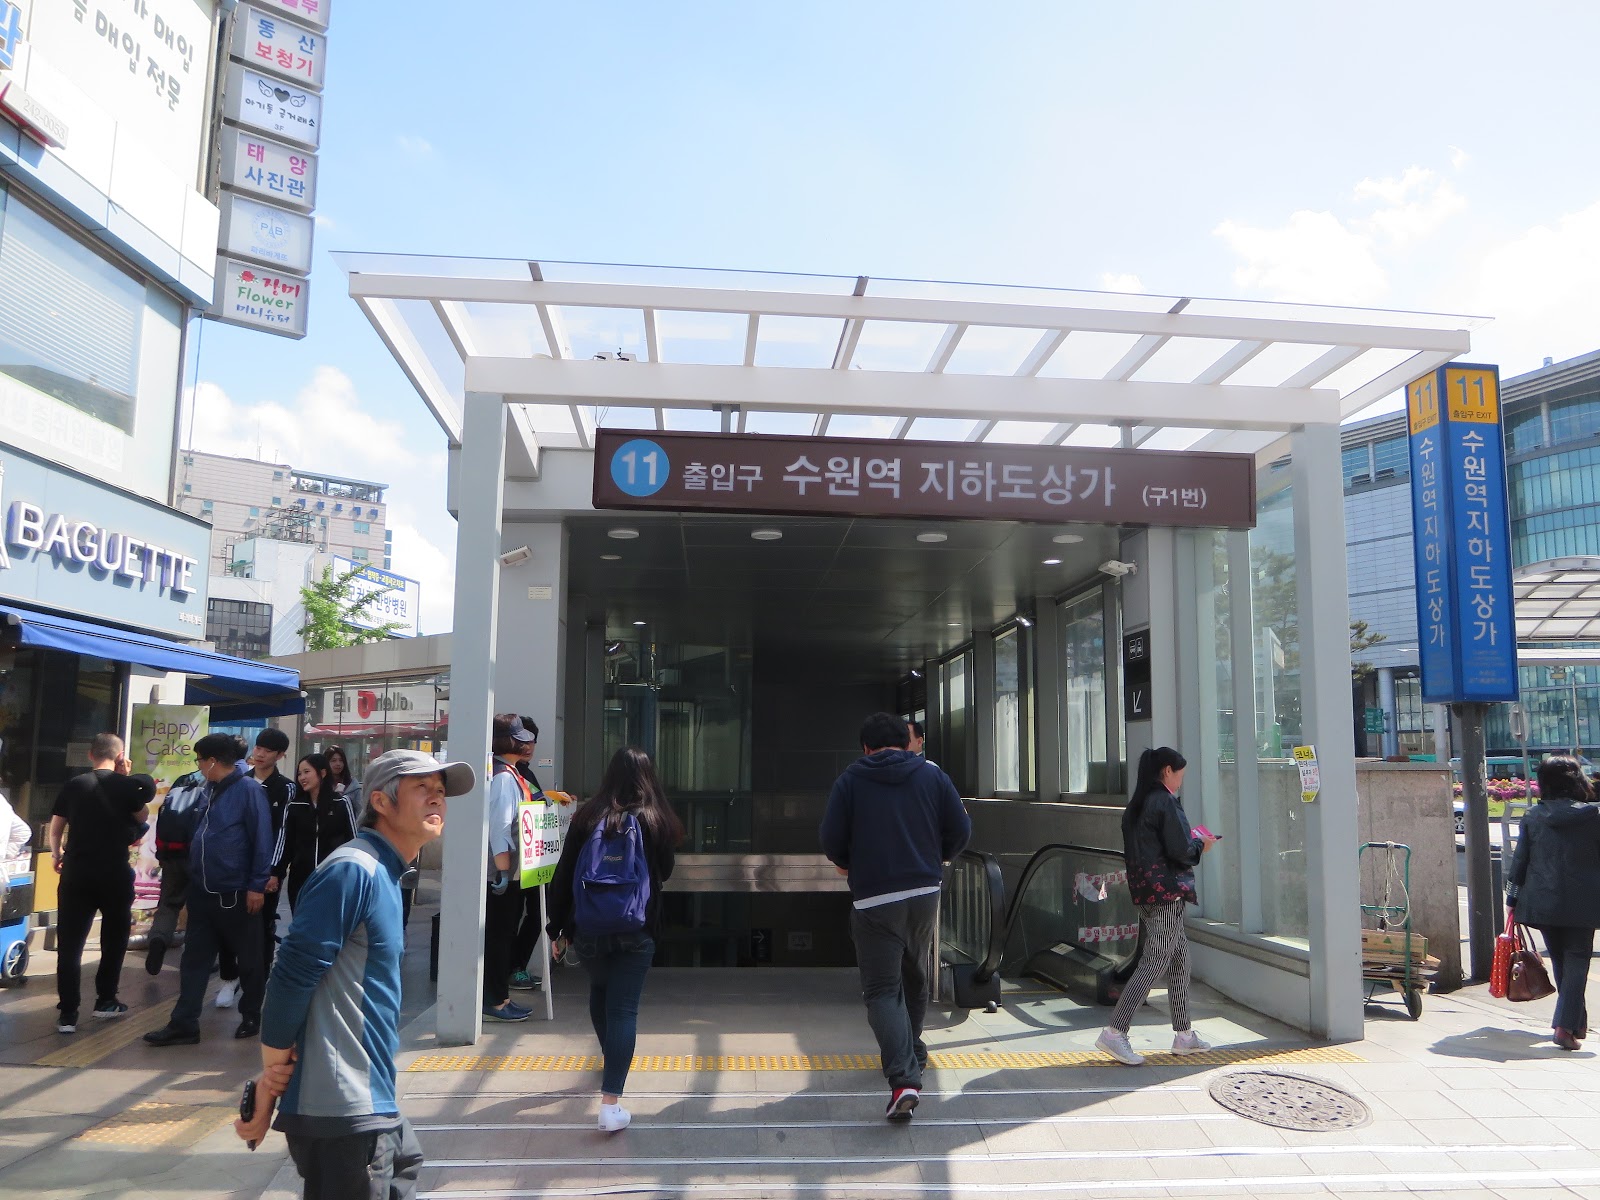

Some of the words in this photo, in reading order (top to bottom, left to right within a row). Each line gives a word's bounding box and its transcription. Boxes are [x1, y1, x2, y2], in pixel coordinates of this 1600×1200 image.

[153, 13, 193, 74] 매입
[255, 41, 313, 77] 보청기
[95, 9, 141, 75] 매입
[146, 56, 181, 112] 전문
[244, 165, 305, 198] 사진관
[237, 286, 294, 309] Flower
[262, 277, 300, 298] 장미
[1415, 380, 1433, 414] 11
[1456, 375, 1484, 407] 11
[1476, 411, 1492, 419] EXIT
[621, 450, 657, 486] 11
[682, 462, 763, 492] 출입구
[782, 455, 901, 499] 수원역
[919, 460, 1116, 506] 지하도상가
[1142, 485, 1207, 510] (구1번)
[10, 500, 198, 595] BAGUETTE
[141, 720, 200, 740] Happy
[146, 738, 191, 756] Cake
